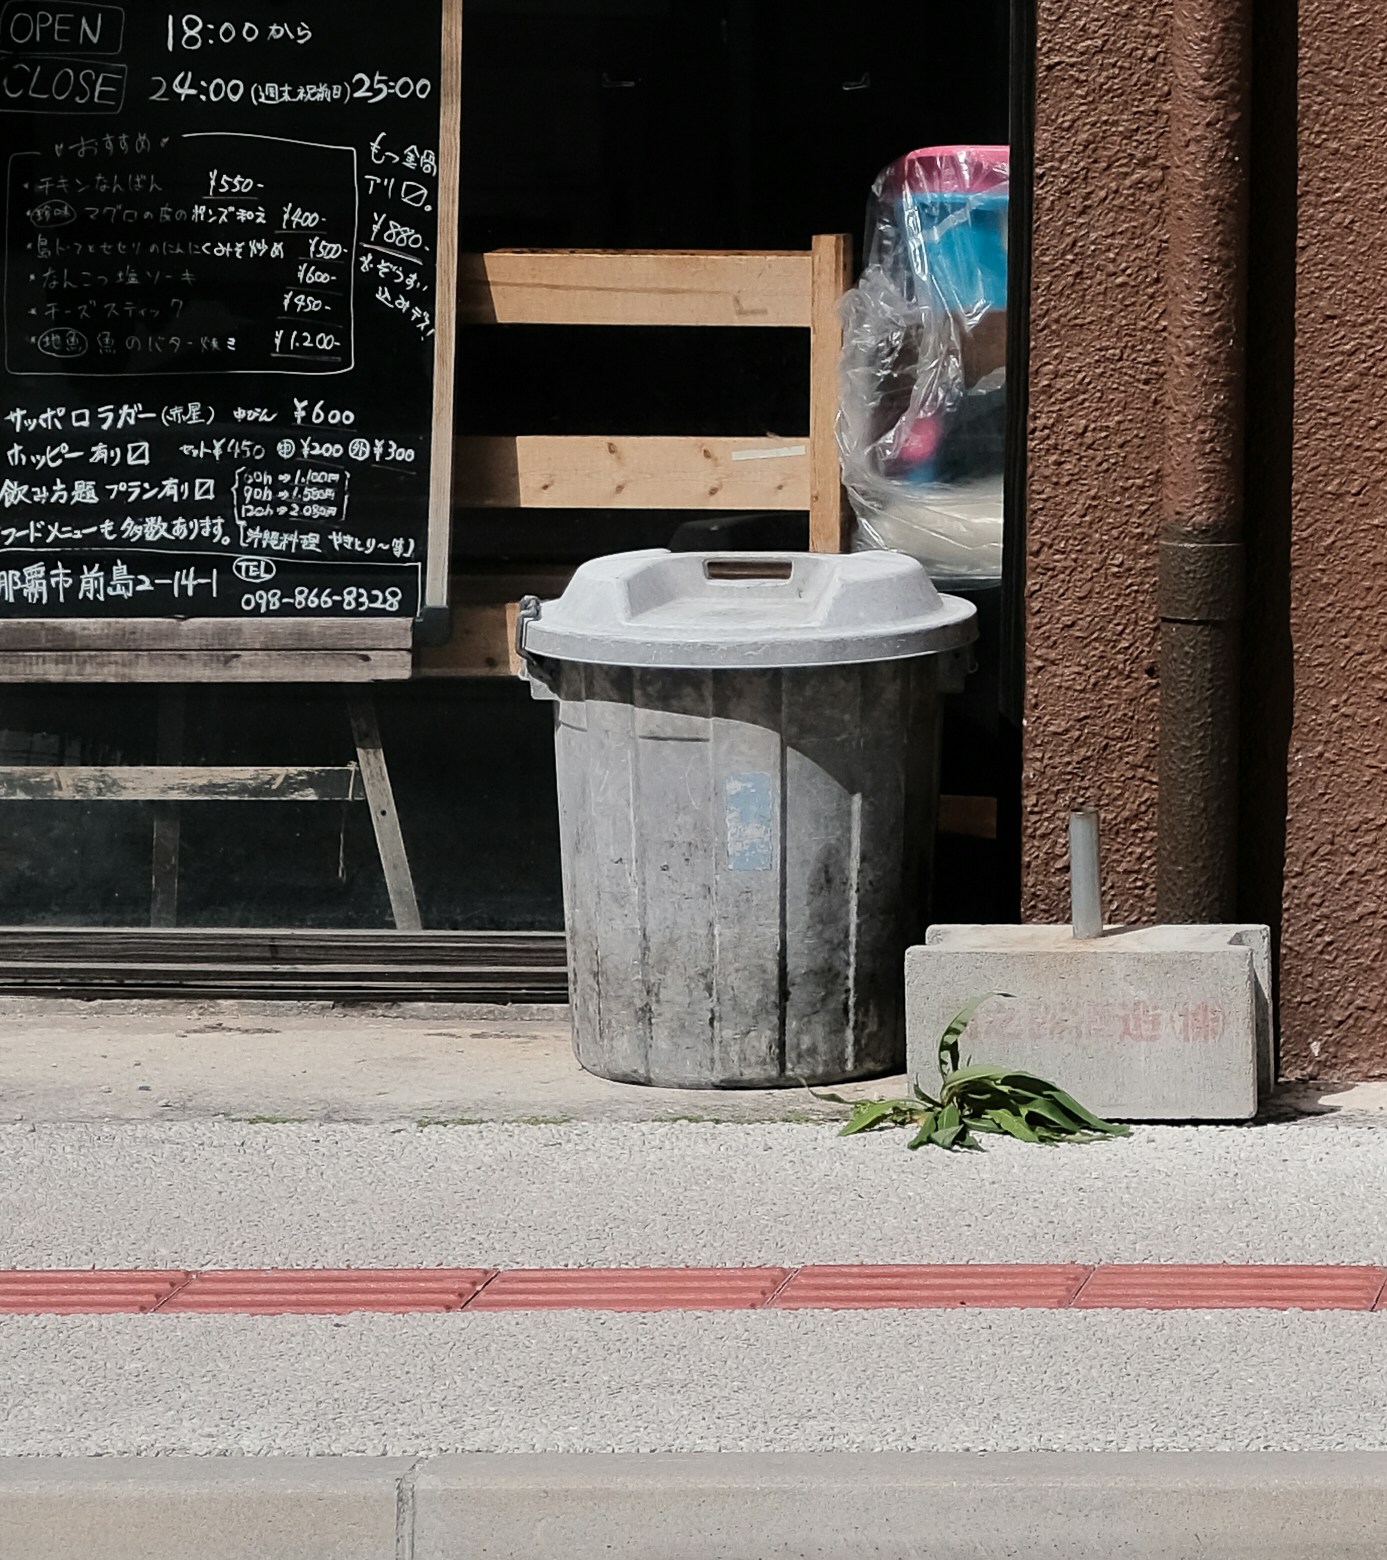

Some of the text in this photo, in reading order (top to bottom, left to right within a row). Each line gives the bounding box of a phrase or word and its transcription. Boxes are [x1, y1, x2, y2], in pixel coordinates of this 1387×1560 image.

[10, 11, 103, 46] OPEN
[2, 63, 124, 106] CLOSE
[68, 132, 152, 158] おすすめ
[370, 132, 438, 177] もつ鍋
[39, 174, 164, 195] チキンなんばん
[44, 299, 185, 320] チーズスティック
[293, 398, 356, 427] ¥600
[300, 436, 344, 459] ¥200
[373, 439, 416, 462] ¥300
[238, 561, 272, 579] TEL
[241, 584, 403, 613] 098-866-8328
